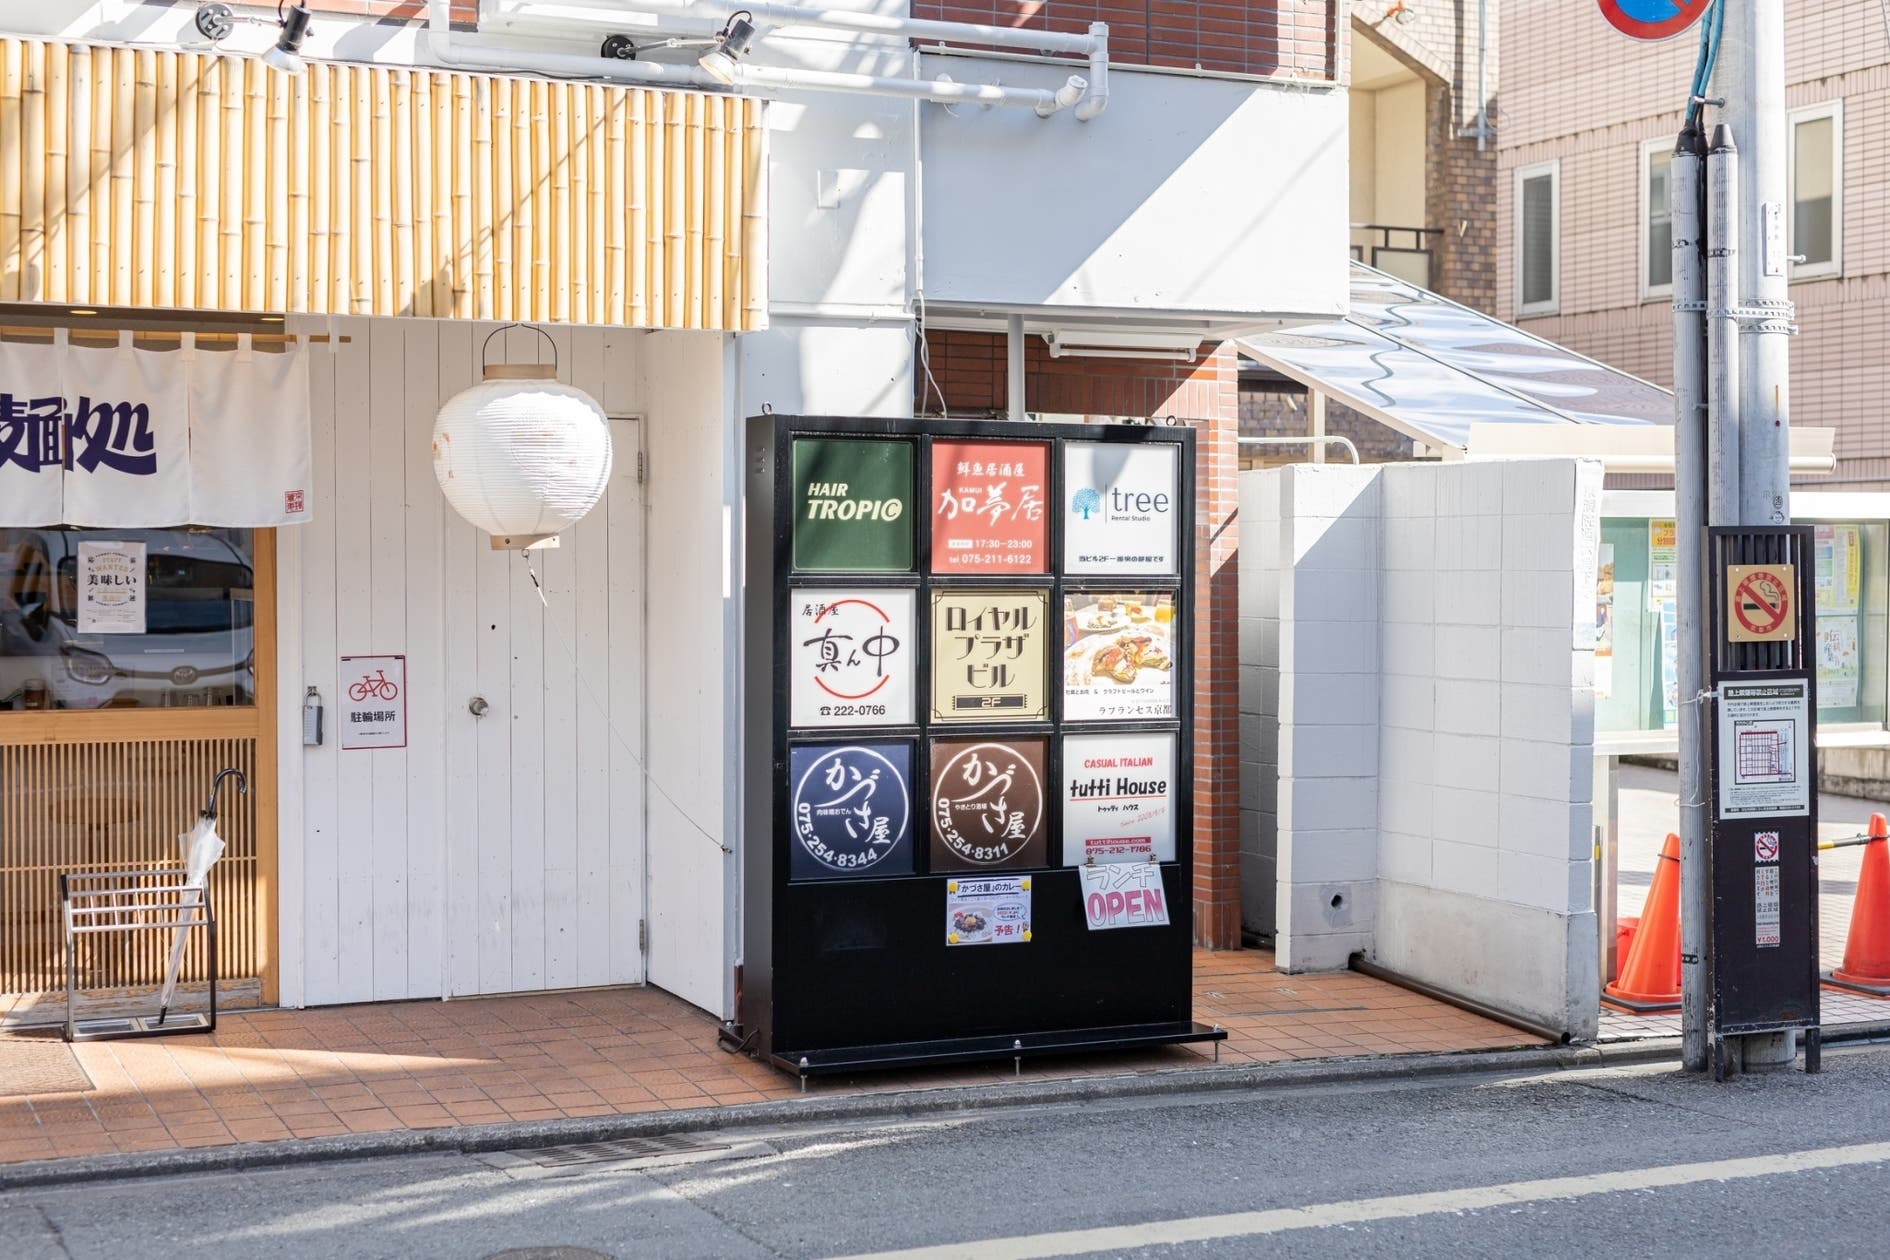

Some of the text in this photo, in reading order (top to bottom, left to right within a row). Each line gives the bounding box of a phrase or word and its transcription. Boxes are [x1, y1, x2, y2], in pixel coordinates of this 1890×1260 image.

[807, 482, 849, 497] HAIR
[1111, 487, 1169, 513] tree
[962, 554, 1032, 564] 075-211-6122
[88, 574, 137, 586] 美味しい
[802, 603, 840, 617] 居酒屋
[946, 606, 1037, 631] ロイヤル
[803, 625, 900, 677] 真ん中
[954, 633, 1030, 660] プラザ
[967, 663, 1016, 688] ビル
[834, 705, 886, 716] 222-0766
[981, 697, 1002, 707] 2F
[350, 711, 396, 723] 駐輪場所
[1084, 757, 1153, 768] CASUAL ITALIAN
[1070, 777, 1167, 797] tutti House
[1087, 863, 1154, 890] ランチ
[1087, 889, 1165, 927] OPEN
